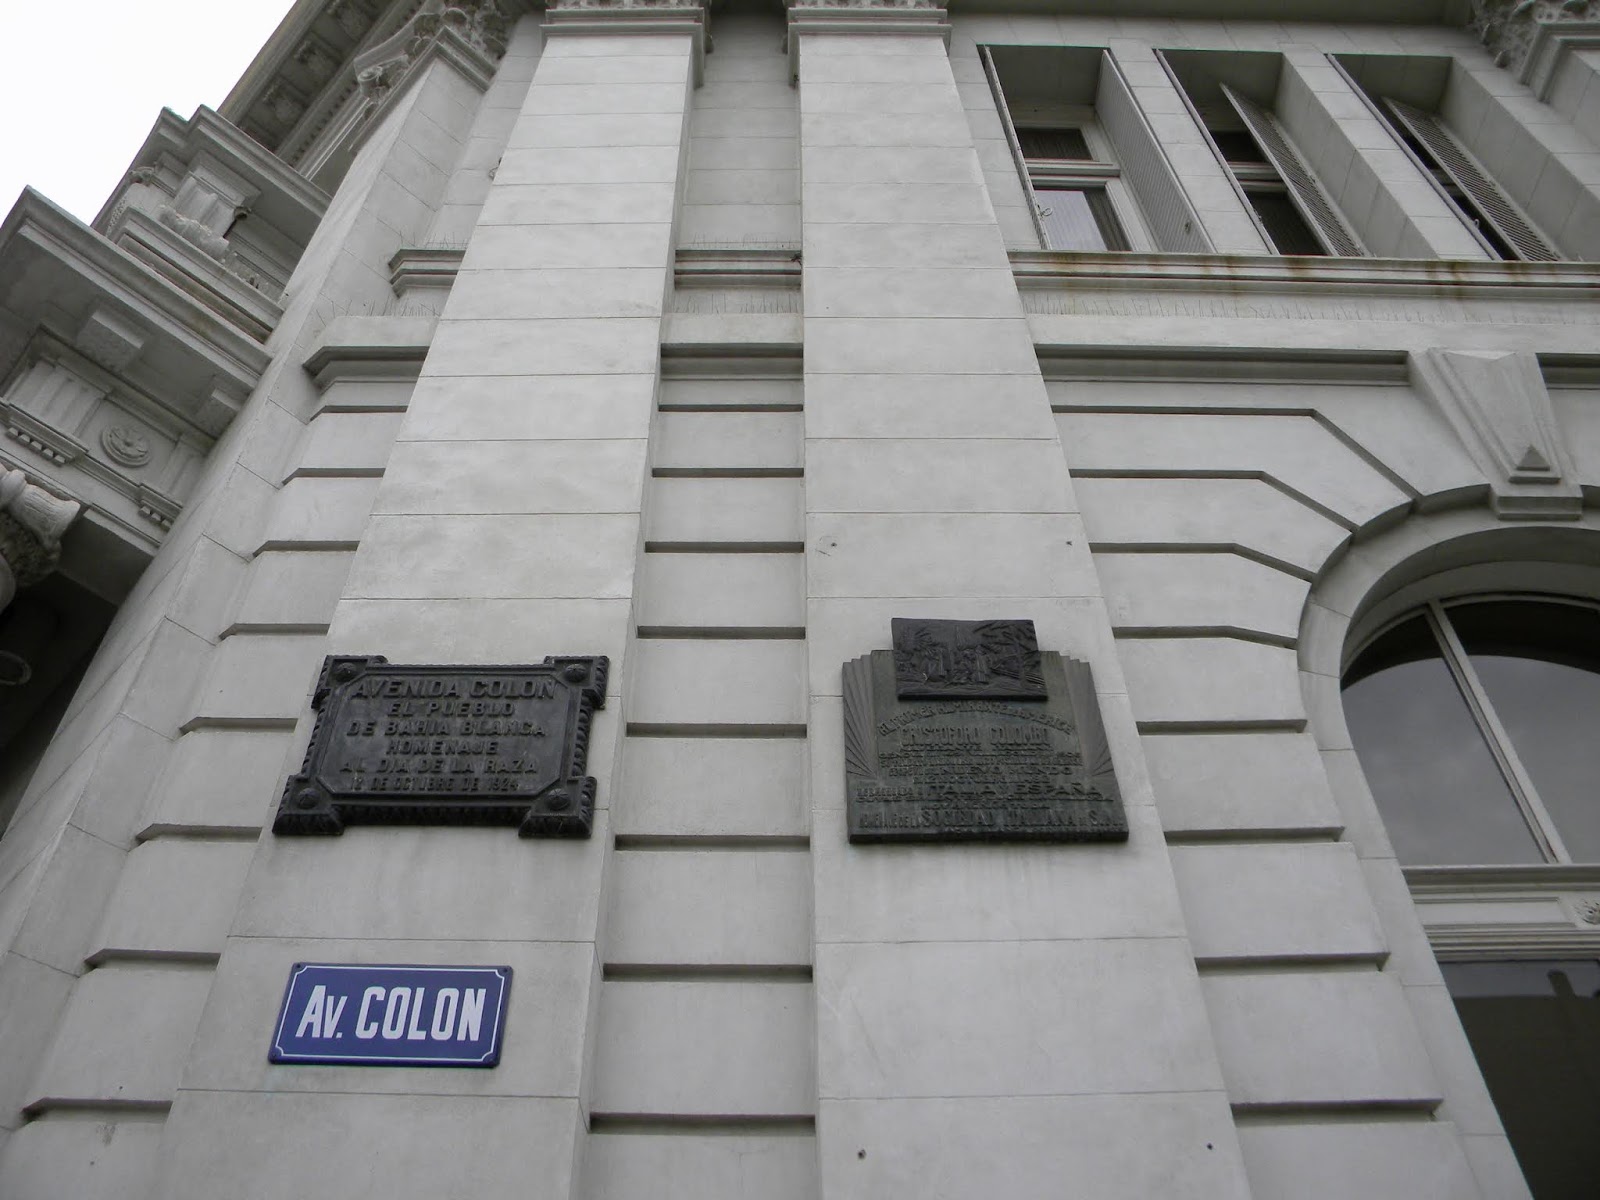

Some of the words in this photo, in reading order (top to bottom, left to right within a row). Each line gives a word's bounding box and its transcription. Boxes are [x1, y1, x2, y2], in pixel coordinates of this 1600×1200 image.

[352, 680, 460, 699] AVENIDA
[469, 680, 554, 699] COLON
[387, 702, 414, 717] EL
[427, 702, 515, 717] PUEBLO
[346, 721, 377, 736] DE
[384, 721, 449, 736] BAHIA
[460, 721, 546, 737] BLANCA
[386, 741, 500, 756] HOMENAJE
[339, 758, 365, 773] AL
[376, 758, 409, 773] DIA
[418, 758, 445, 774] DE
[451, 758, 475, 774] LA
[484, 758, 537, 774] RAZA
[1014, 781, 1103, 798] ESPAÑA
[295, 984, 348, 1039] Av.
[355, 985, 487, 1041] COLON
